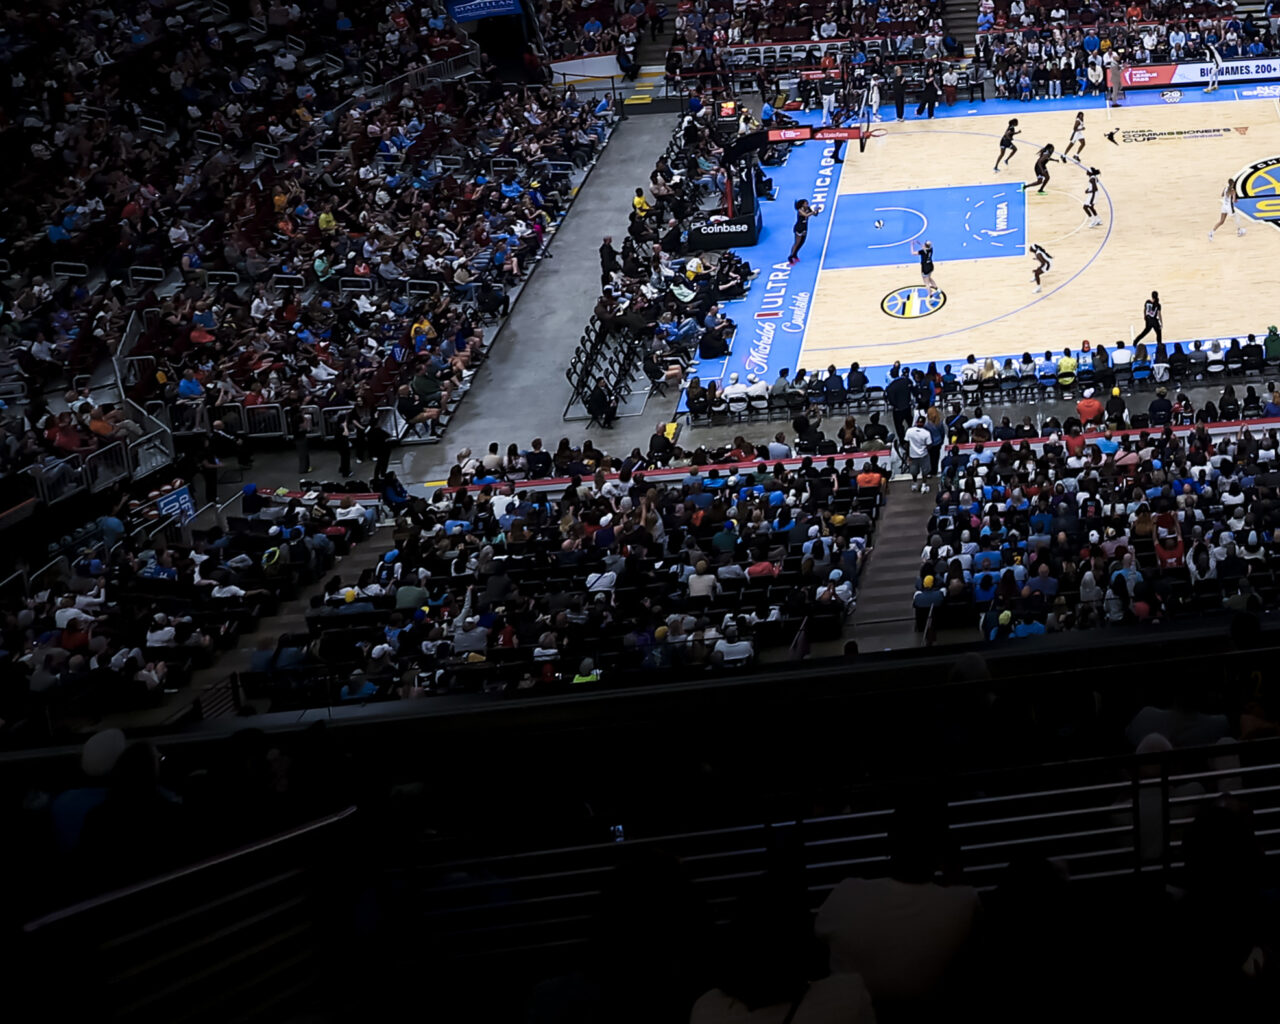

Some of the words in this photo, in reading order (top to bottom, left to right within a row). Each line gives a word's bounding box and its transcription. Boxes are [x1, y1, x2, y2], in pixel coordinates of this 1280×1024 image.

[1255, 63, 1277, 74] 200+
[1122, 127, 1231, 139] COMMISSIONER'S
[701, 223, 748, 234] coinbase
[745, 320, 776, 375] Michelob
[761, 261, 792, 309] ULTRA
